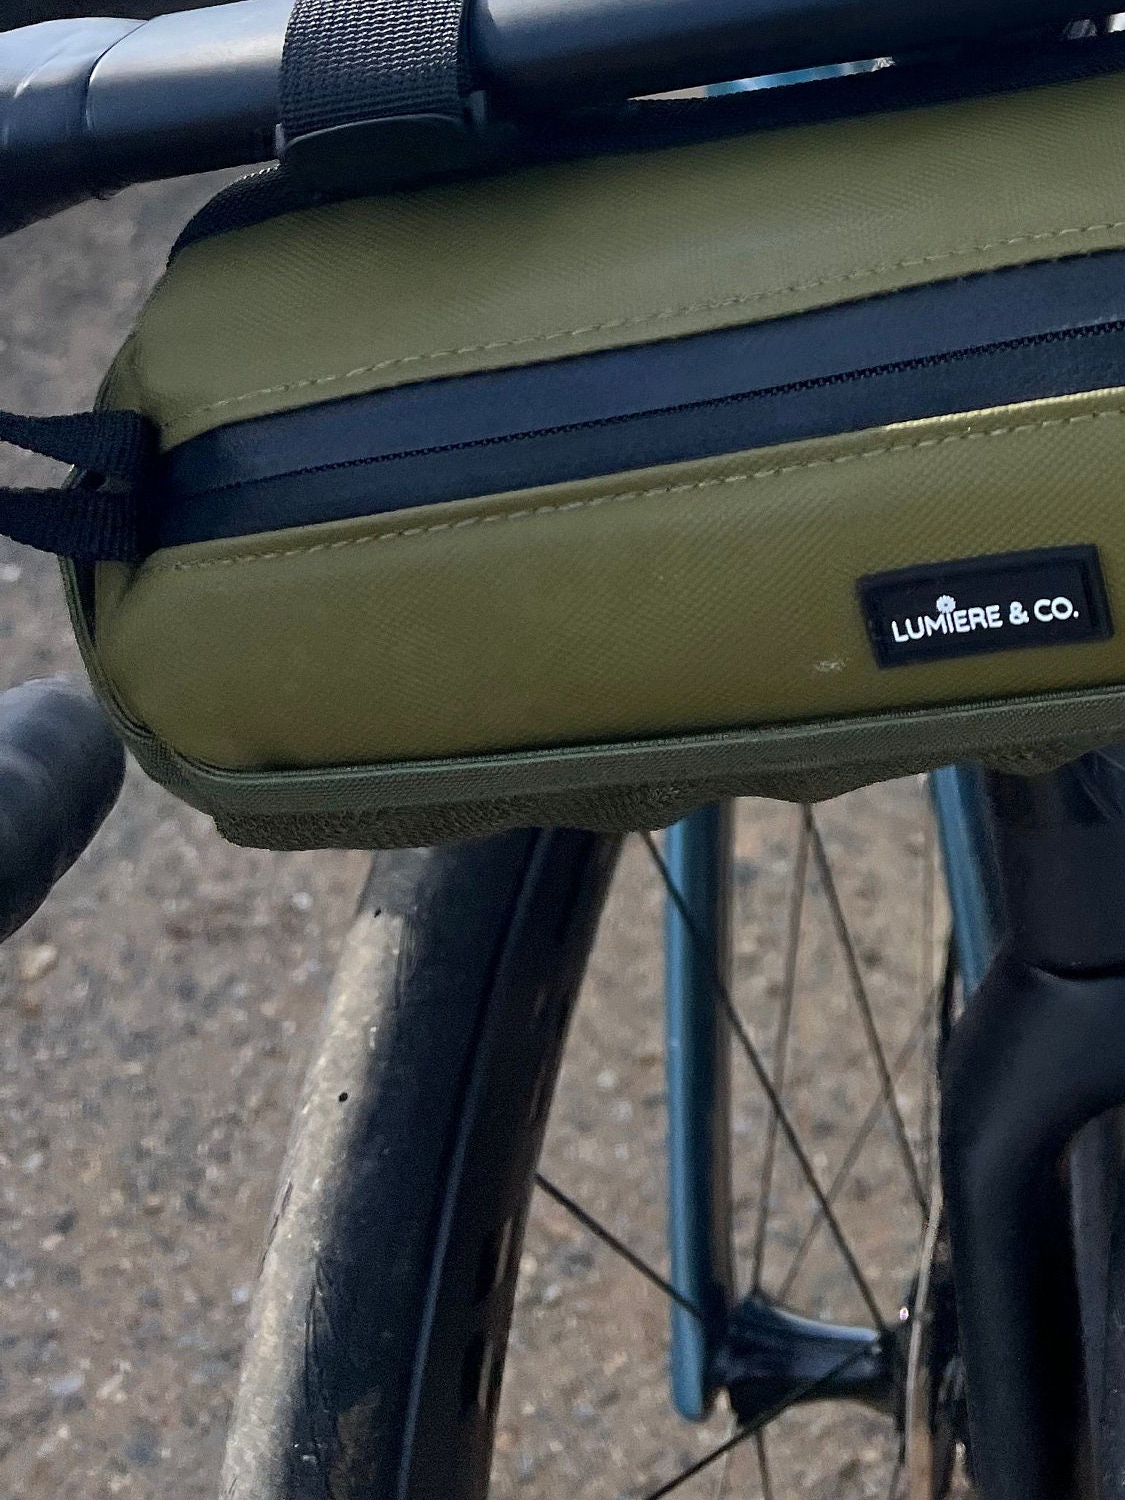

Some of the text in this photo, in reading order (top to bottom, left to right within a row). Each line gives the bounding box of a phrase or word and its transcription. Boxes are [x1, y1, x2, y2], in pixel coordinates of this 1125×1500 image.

[891, 595, 1080, 642] LUMIERE & CO.
